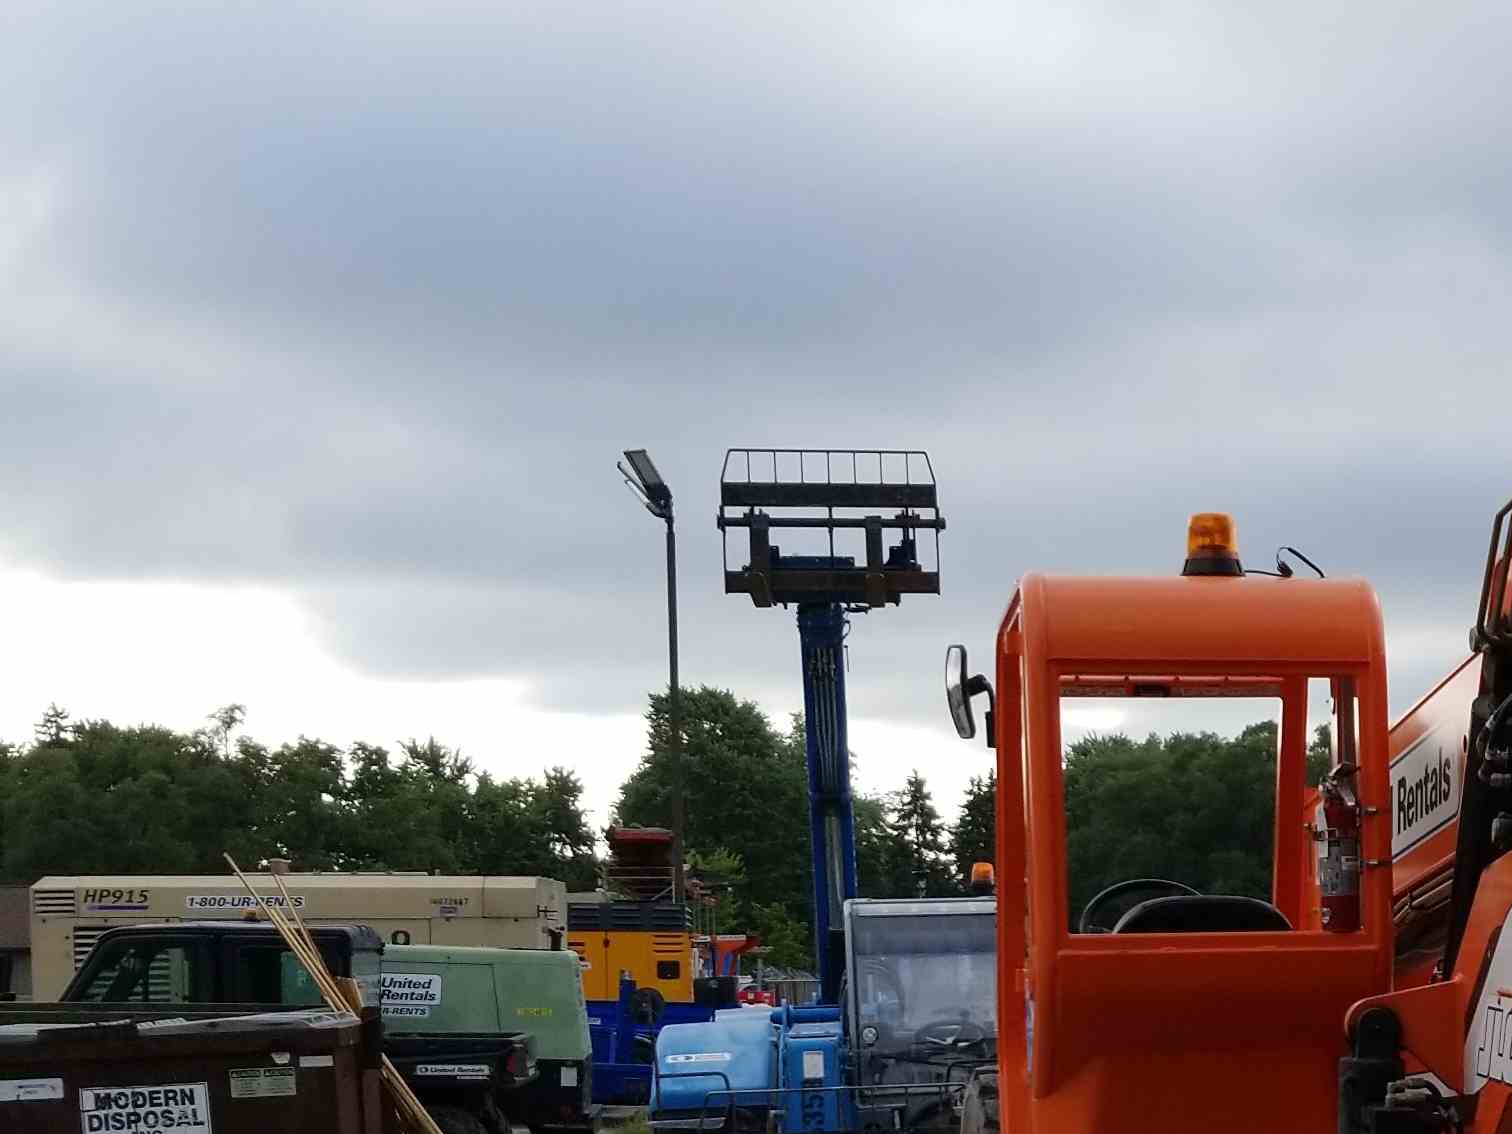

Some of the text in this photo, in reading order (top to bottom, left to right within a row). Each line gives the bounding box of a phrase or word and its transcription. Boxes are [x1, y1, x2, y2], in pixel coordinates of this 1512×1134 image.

[1397, 745, 1452, 834] Rentals
[83, 888, 151, 904] HP915
[381, 976, 433, 989] United
[380, 989, 438, 1001] Rentals
[93, 1087, 196, 1110] MODERN
[87, 1108, 205, 1133] DISPOSAL
